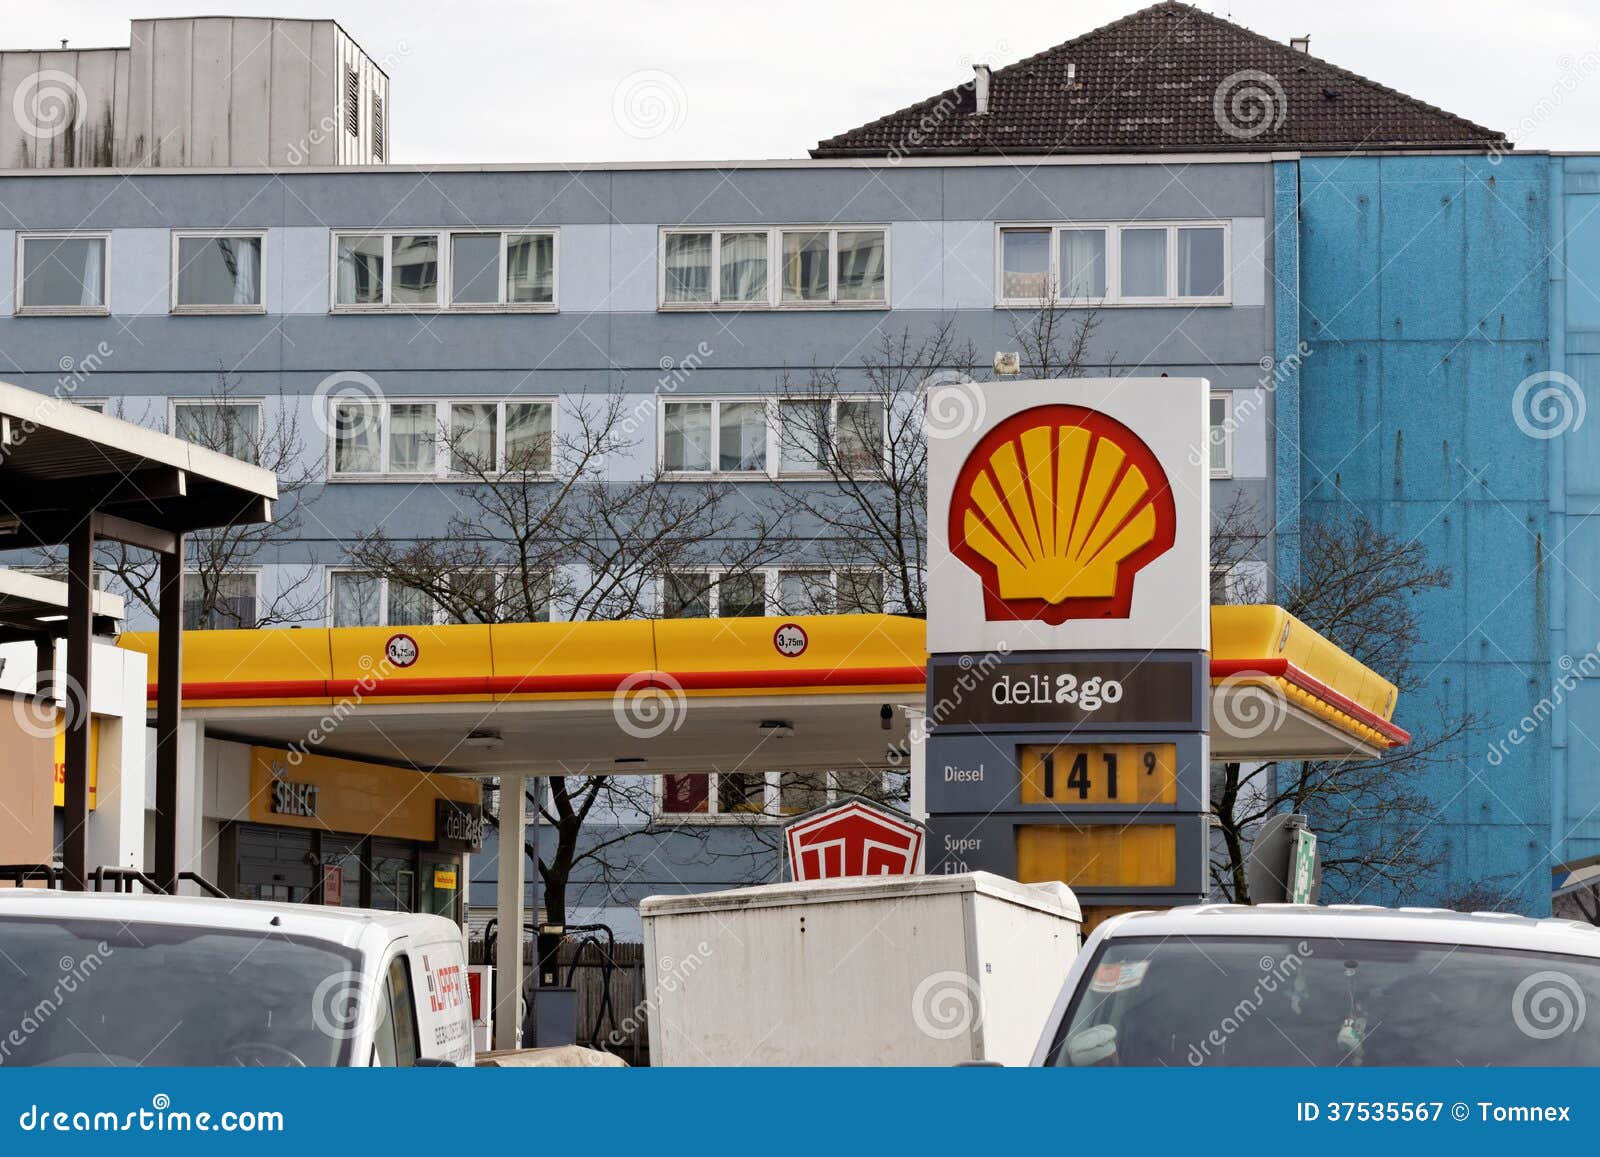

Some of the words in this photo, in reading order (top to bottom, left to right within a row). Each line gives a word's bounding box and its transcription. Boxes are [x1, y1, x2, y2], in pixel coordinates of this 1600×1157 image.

[991, 673, 1123, 711] deli2go
[944, 764, 984, 782] Diesel
[276, 781, 321, 817] SELECT
[944, 835, 982, 854] Super
